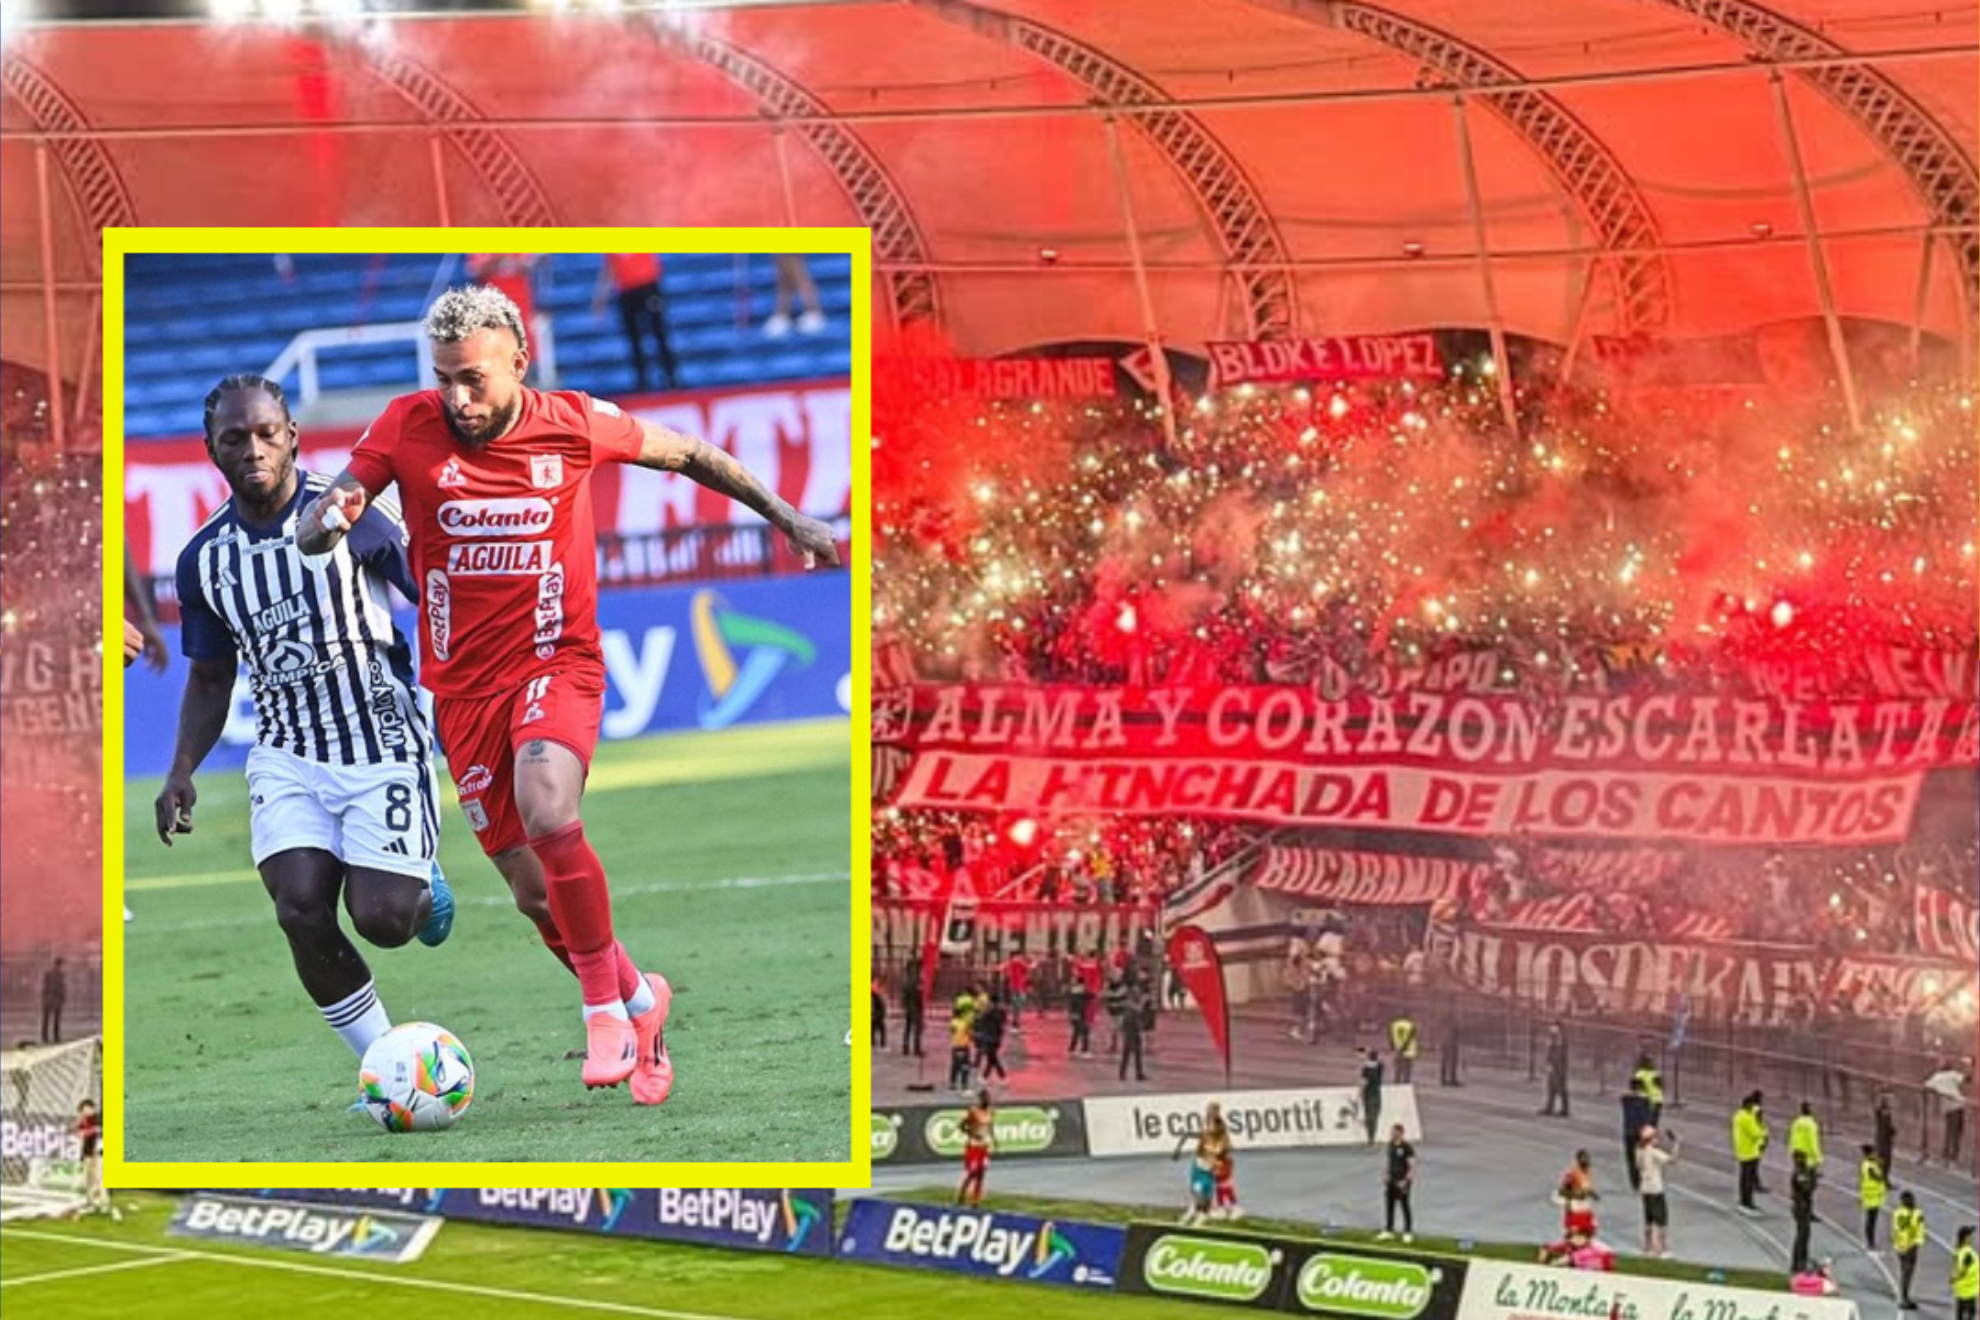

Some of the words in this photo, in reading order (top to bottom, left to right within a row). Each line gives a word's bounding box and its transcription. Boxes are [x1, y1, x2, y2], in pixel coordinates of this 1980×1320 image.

[1337, 334, 1444, 378] LOPEZ
[440, 507, 549, 528] Colanta
[453, 544, 543, 572] AGUILA
[251, 597, 313, 636] AGUILA
[919, 687, 1128, 749] ALMA
[1147, 687, 1192, 748] Y
[1207, 686, 1541, 762] CORAZON
[1553, 692, 1950, 770] ESCARLATA
[385, 783, 411, 832] 8
[925, 757, 1011, 805] LA
[1039, 763, 1393, 820] HINCHADA
[1418, 776, 1498, 829] DE
[1511, 778, 1641, 829] LOS
[1655, 780, 1906, 838] CANTOS
[1134, 1107, 1162, 1140] le
[1167, 1110, 1203, 1138] co
[1226, 1099, 1325, 1141] sportif
[186, 1201, 356, 1252] BetPlay
[659, 1188, 777, 1242] BetPlay
[884, 1207, 1035, 1276] BetPlay
[1150, 1244, 1265, 1288] Colanta
[1301, 1261, 1428, 1306] Colanta
